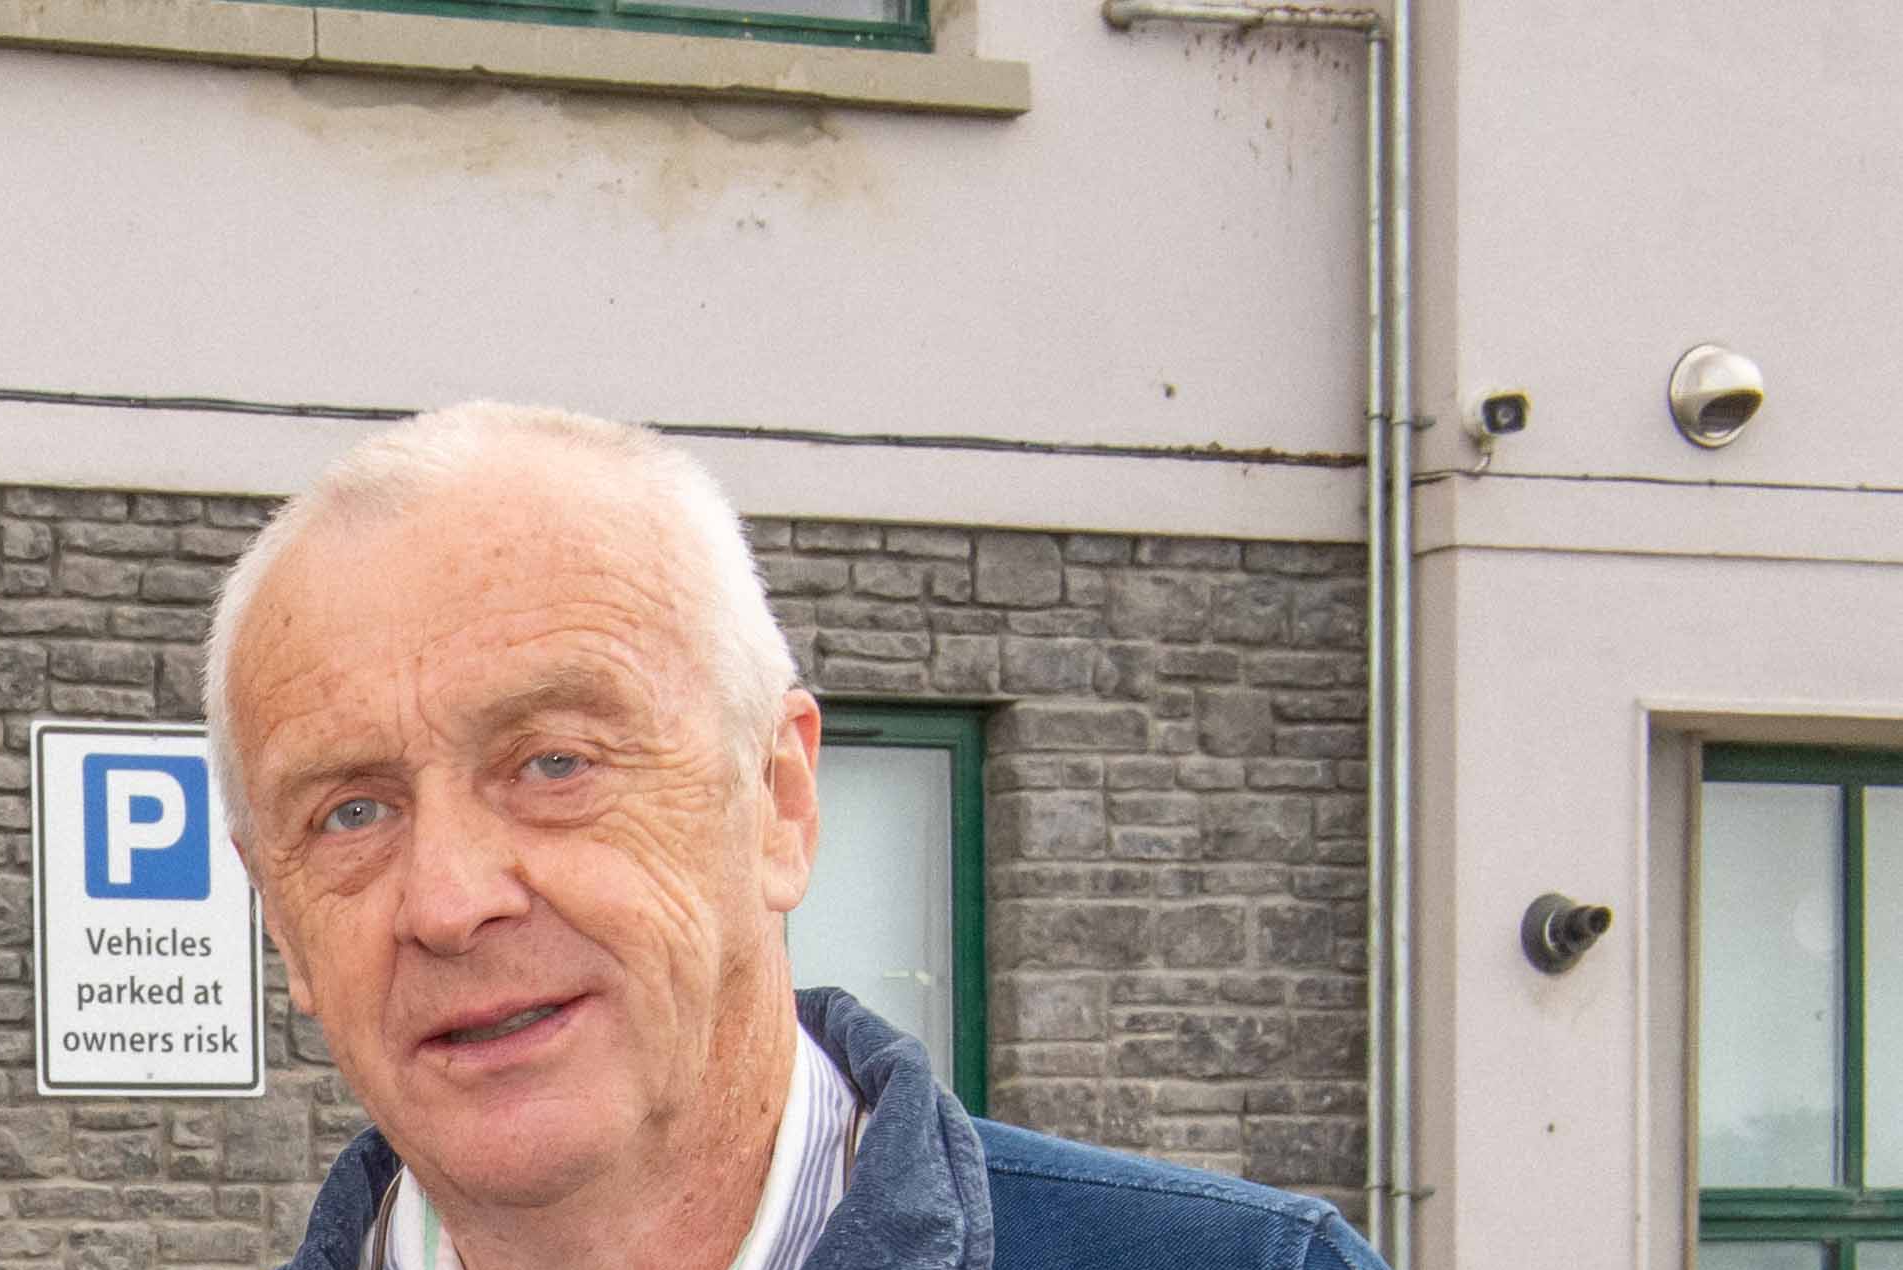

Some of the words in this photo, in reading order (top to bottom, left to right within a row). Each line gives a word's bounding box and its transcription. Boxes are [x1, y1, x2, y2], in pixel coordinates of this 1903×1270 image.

[105, 768, 187, 885] P
[85, 927, 212, 957] Vehicles
[77, 976, 185, 1011] parked
[194, 981, 224, 1006] at
[62, 1031, 174, 1053] owners
[183, 1025, 239, 1054] risk
